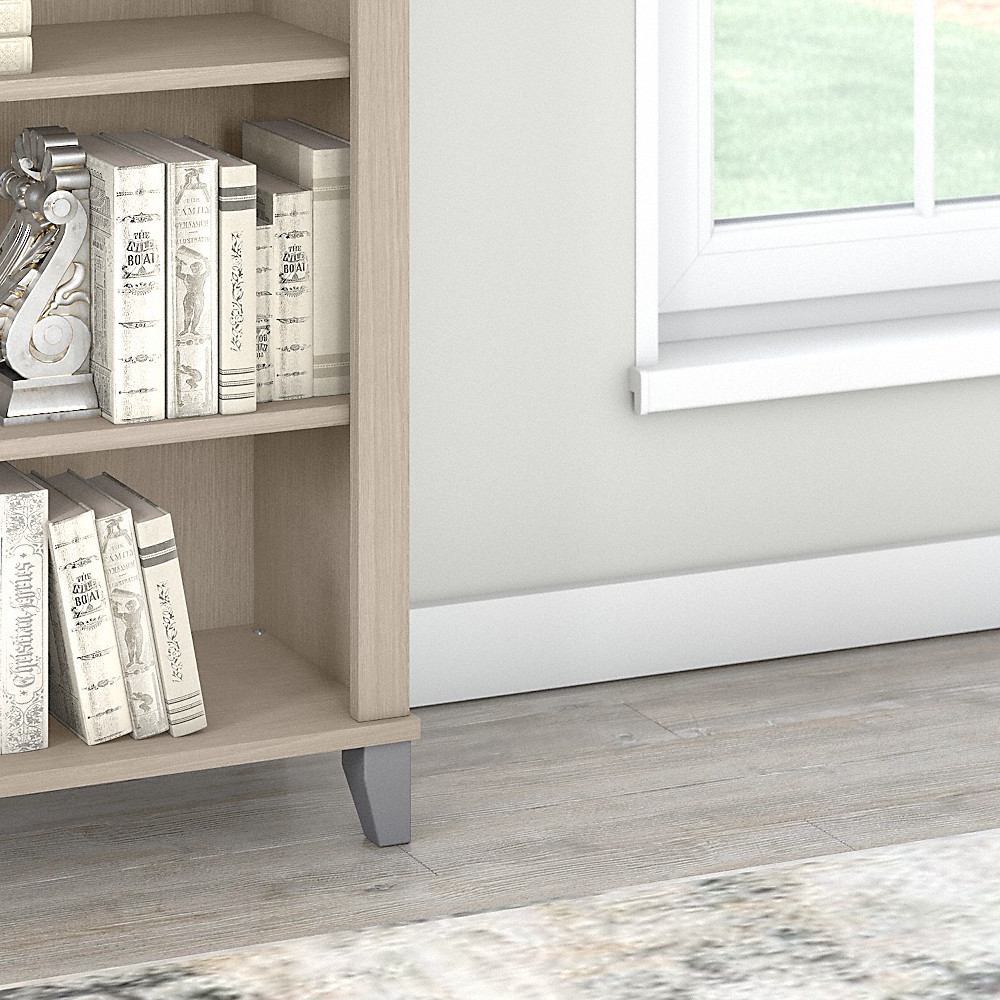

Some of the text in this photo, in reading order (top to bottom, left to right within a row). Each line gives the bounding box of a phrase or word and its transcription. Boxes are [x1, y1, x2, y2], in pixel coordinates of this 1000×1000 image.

[133, 230, 150, 240] THE
[288, 244, 302, 253] THE
[127, 252, 155, 266] BOAT
[283, 262, 306, 274] BOAT
[76, 572, 92, 583] THE
[74, 590, 100, 607] BOAT
[9, 613, 41, 688] Christian
